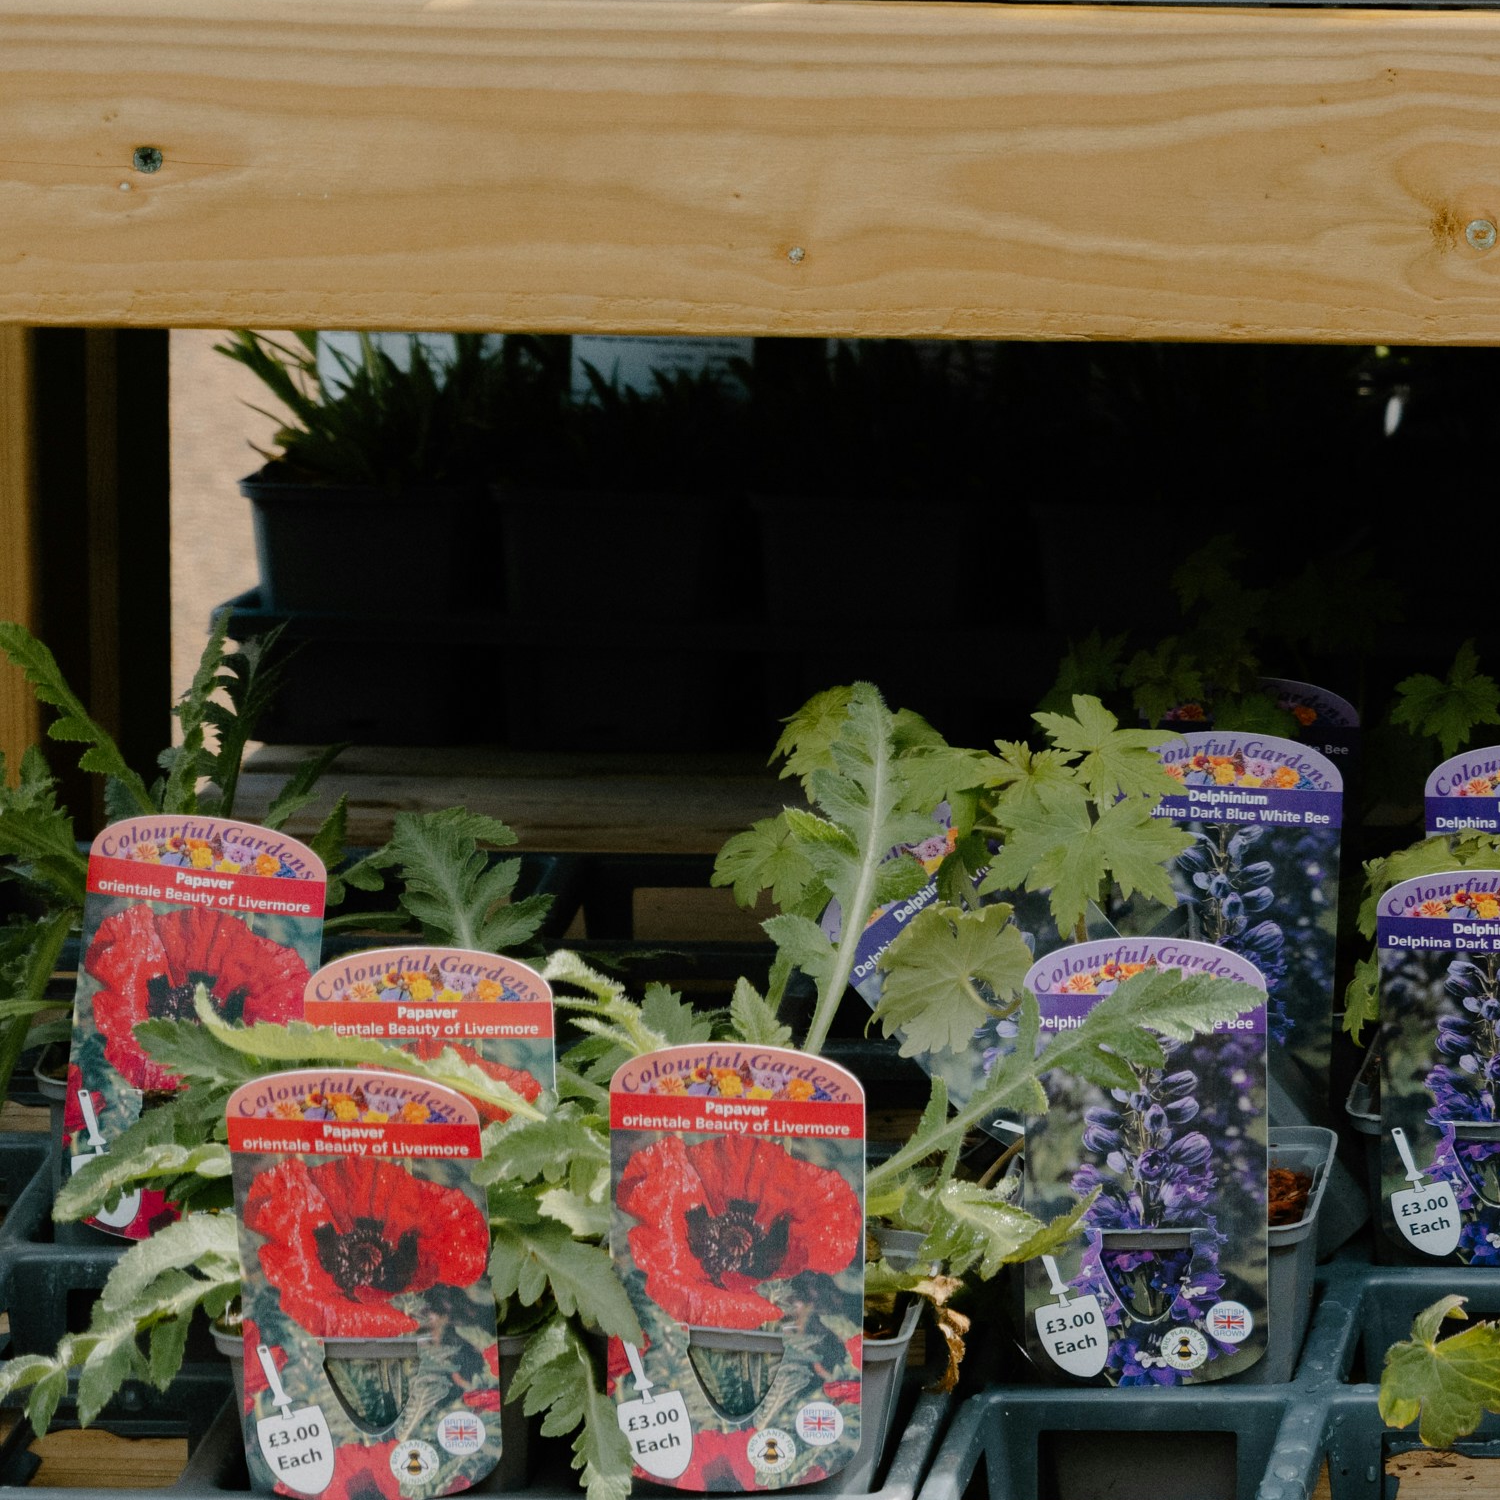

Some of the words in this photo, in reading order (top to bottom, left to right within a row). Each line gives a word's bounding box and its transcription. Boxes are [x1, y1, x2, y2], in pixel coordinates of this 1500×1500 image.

[176, 871, 234, 890] Papaver
[98, 879, 161, 898] orientale
[165, 887, 214, 905] Beauty
[218, 894, 236, 907] of
[238, 895, 315, 913] Livermore
[1387, 877, 1498, 917] Colourful
[1388, 935, 1452, 950] Delphina
[1455, 937, 1489, 950] Dark
[621, 1051, 741, 1093] Colourful
[750, 1054, 852, 1103] Gardens
[705, 1101, 769, 1116] Papaver
[622, 1115, 691, 1130] orientale
[695, 1117, 748, 1134] Beauty
[752, 1119, 770, 1133] of
[774, 1120, 851, 1136] Livermore
[1400, 1196, 1449, 1218] £3.00
[1409, 1217, 1451, 1236] Each
[627, 1408, 679, 1432] £3.00
[635, 1433, 681, 1455] Each
